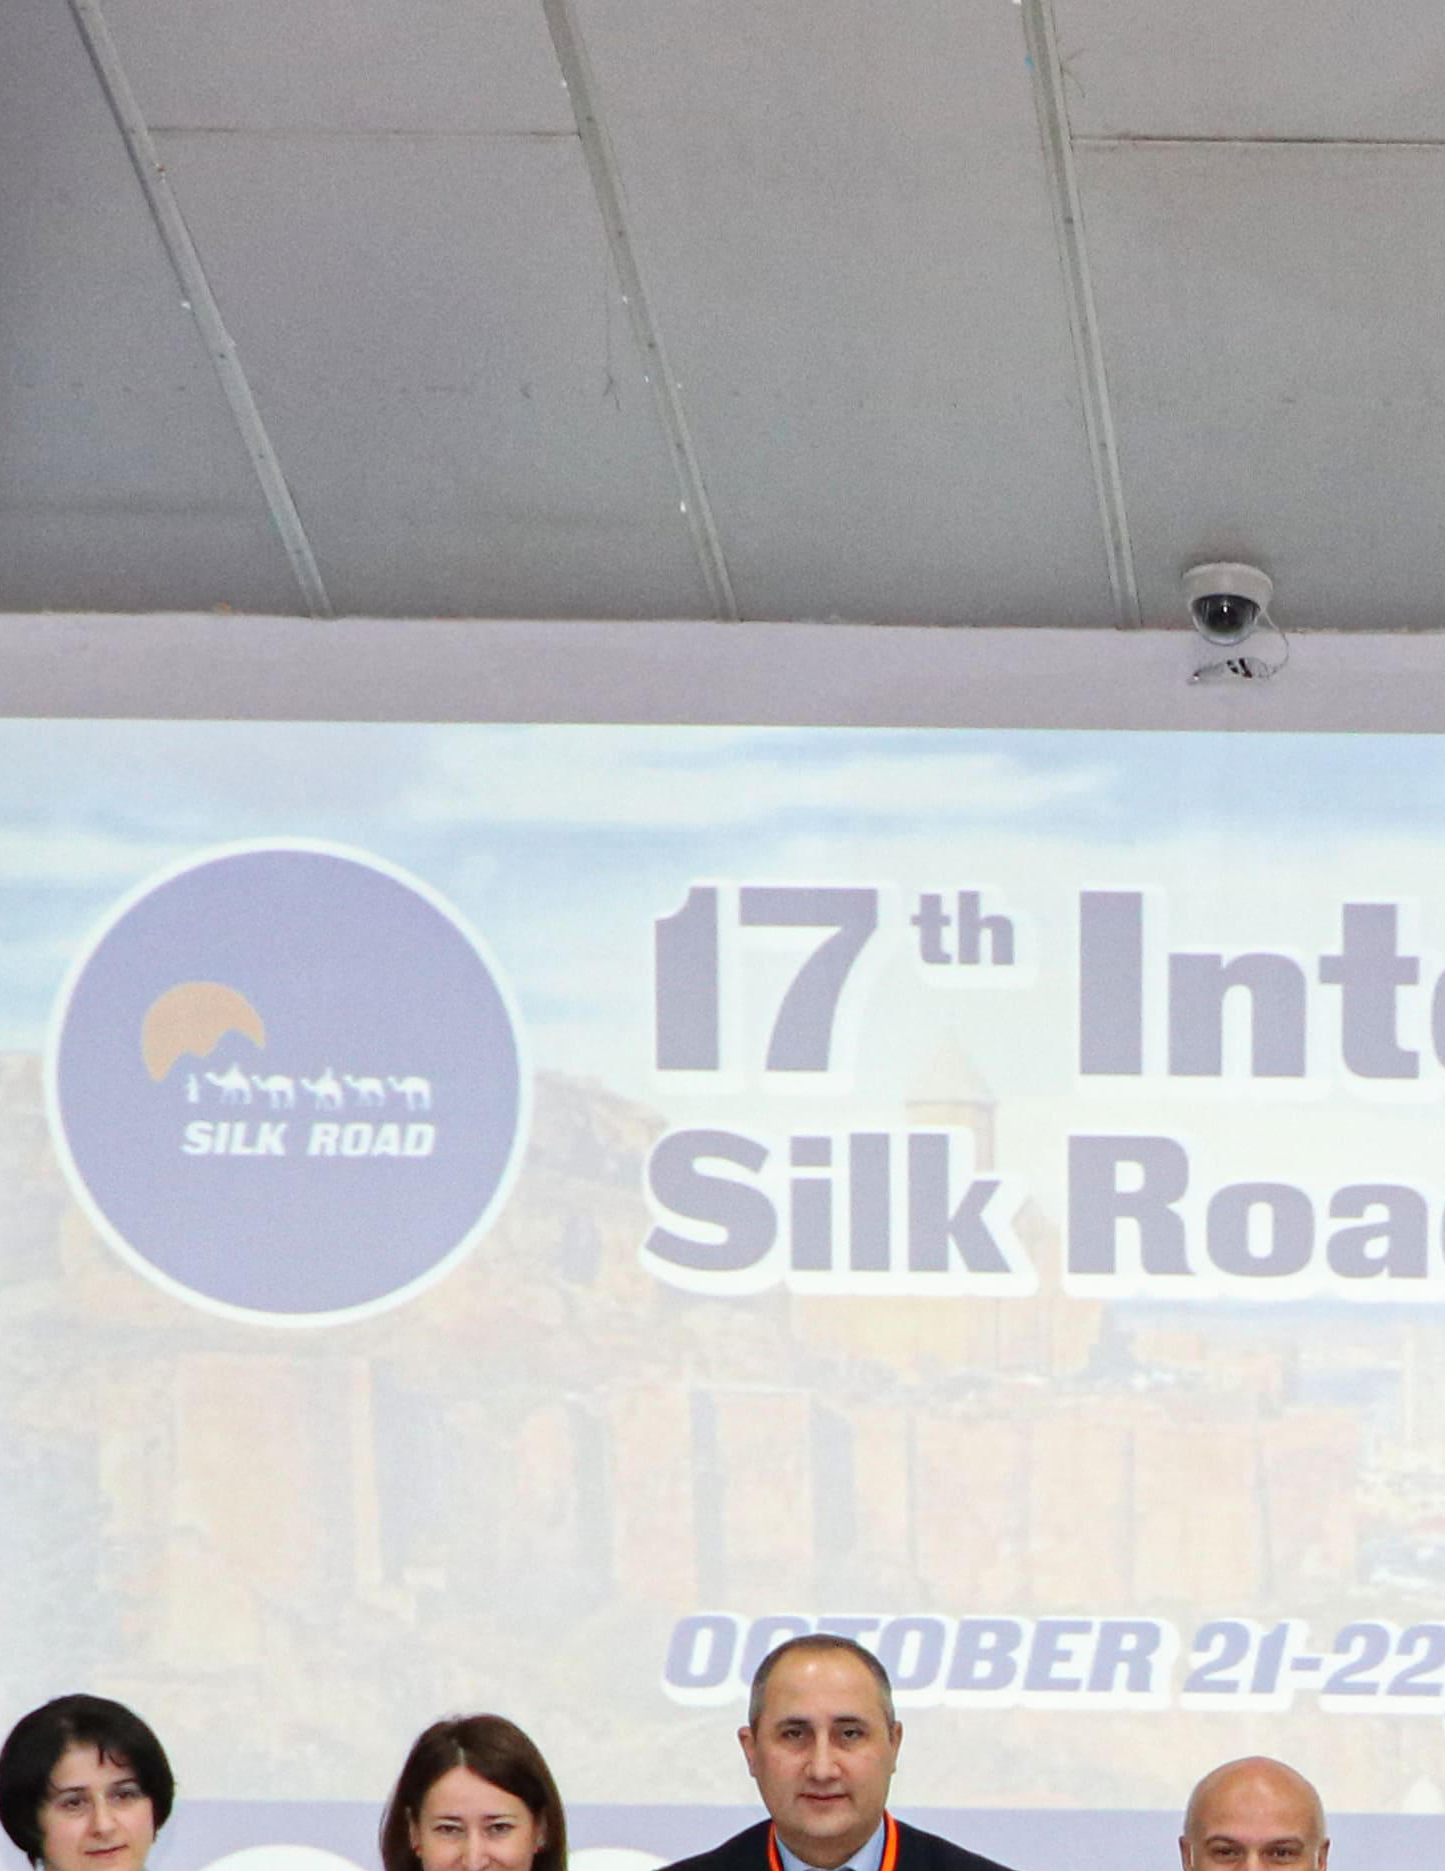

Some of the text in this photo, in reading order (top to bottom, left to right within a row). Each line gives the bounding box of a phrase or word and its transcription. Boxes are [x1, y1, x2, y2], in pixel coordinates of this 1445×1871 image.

[654, 886, 1016, 1074] 17th
[180, 1120, 437, 1158] SILK ROAD
[645, 1128, 1014, 1275] Silk
